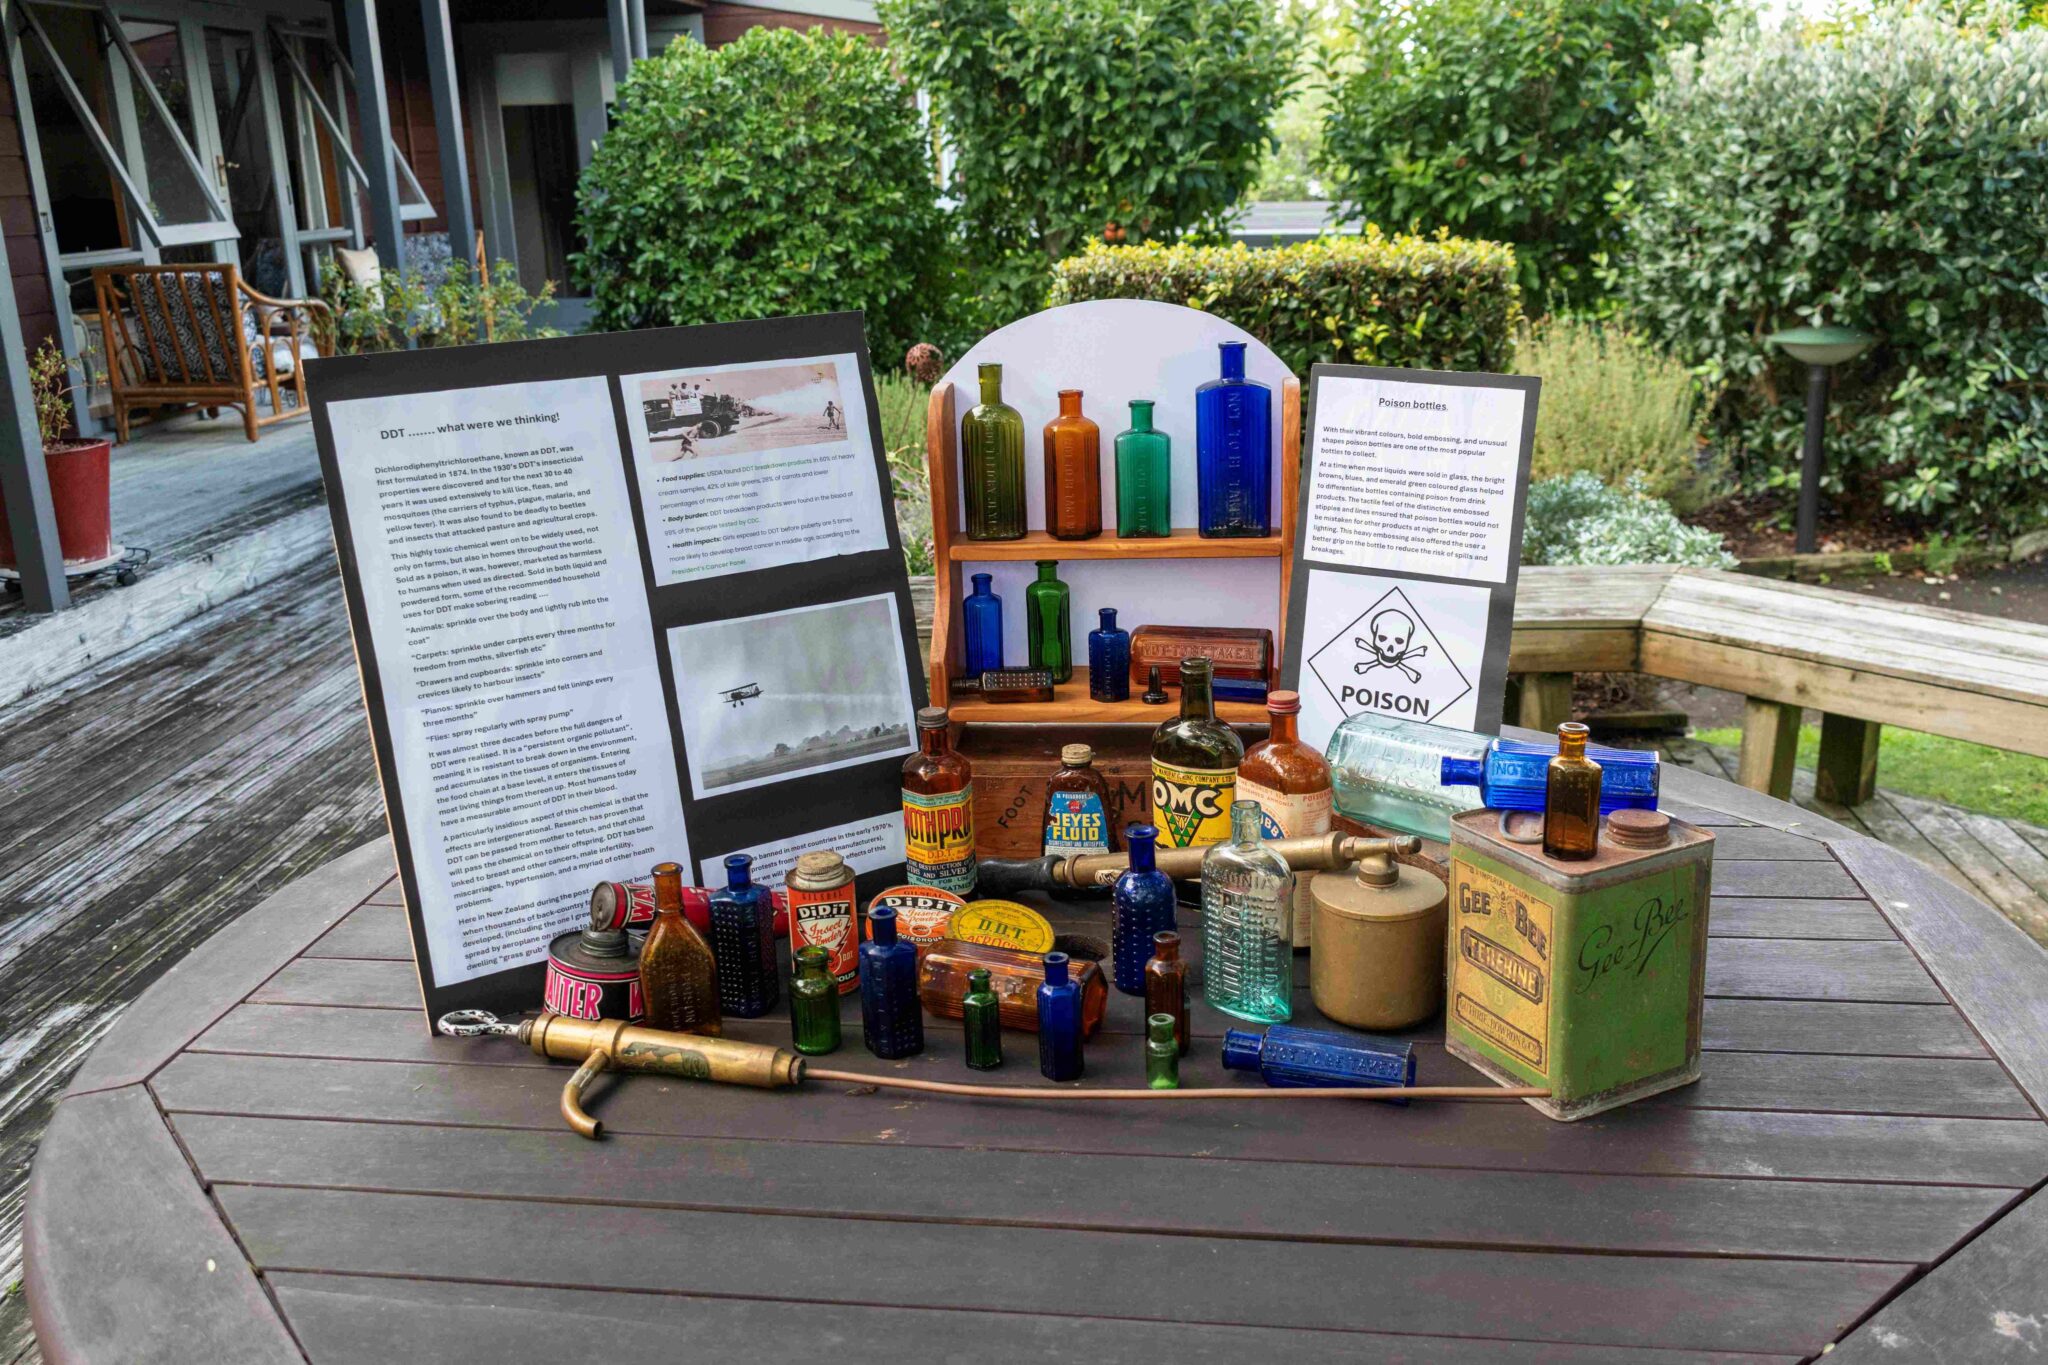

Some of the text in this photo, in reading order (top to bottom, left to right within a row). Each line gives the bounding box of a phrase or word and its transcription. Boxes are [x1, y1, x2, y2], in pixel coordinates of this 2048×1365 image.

[1378, 397, 1411, 407] Poison
[380, 428, 405, 439] DDT
[436, 422, 465, 433] what
[466, 420, 494, 430] were
[495, 418, 512, 427] we
[514, 412, 560, 425] thinking!
[1322, 436, 1344, 444] shapes
[1368, 440, 1392, 448] bottles
[1354, 428, 1378, 436] vibrant
[1378, 431, 1406, 439] colours,
[1406, 432, 1422, 440] bold
[1423, 434, 1462, 444] embossing,
[540, 446, 558, 454] DDT,
[376, 478, 393, 486] first
[394, 472, 438, 483] formulated
[541, 455, 584, 466] insecticidal
[1383, 466, 1406, 474] liquids
[1470, 474, 1483, 482] the
[1484, 476, 1505, 484] bright
[390, 552, 408, 560] This
[409, 548, 433, 558] highly
[433, 546, 453, 554] toxic
[453, 540, 489, 551] chemical
[489, 538, 508, 546] went
[540, 530, 564, 539] widely
[564, 527, 585, 536] used,
[1341, 685, 1430, 717] POISON
[452, 743, 478, 753] almost
[479, 739, 501, 748] three
[501, 732, 533, 743] decades
[534, 728, 559, 737] before
[573, 721, 586, 729] full
[586, 717, 614, 727] dangers
[1194, 775, 1219, 783] COMPANY
[997, 784, 1034, 829] FOOT
[1152, 777, 1223, 818] OMC
[1050, 813, 1101, 827] JEYES
[758, 848, 782, 859] banned
[790, 842, 806, 852] most
[807, 836, 837, 847] countries
[855, 827, 871, 835] early
[1052, 827, 1099, 841] FLUID
[919, 861, 962, 871] DESTRUCTION
[939, 867, 967, 877] SILVER
[907, 908, 942, 917] Insect
[1459, 882, 1547, 961] GEE BEE
[809, 919, 843, 938] Insect
[545, 969, 603, 1022] AITER
